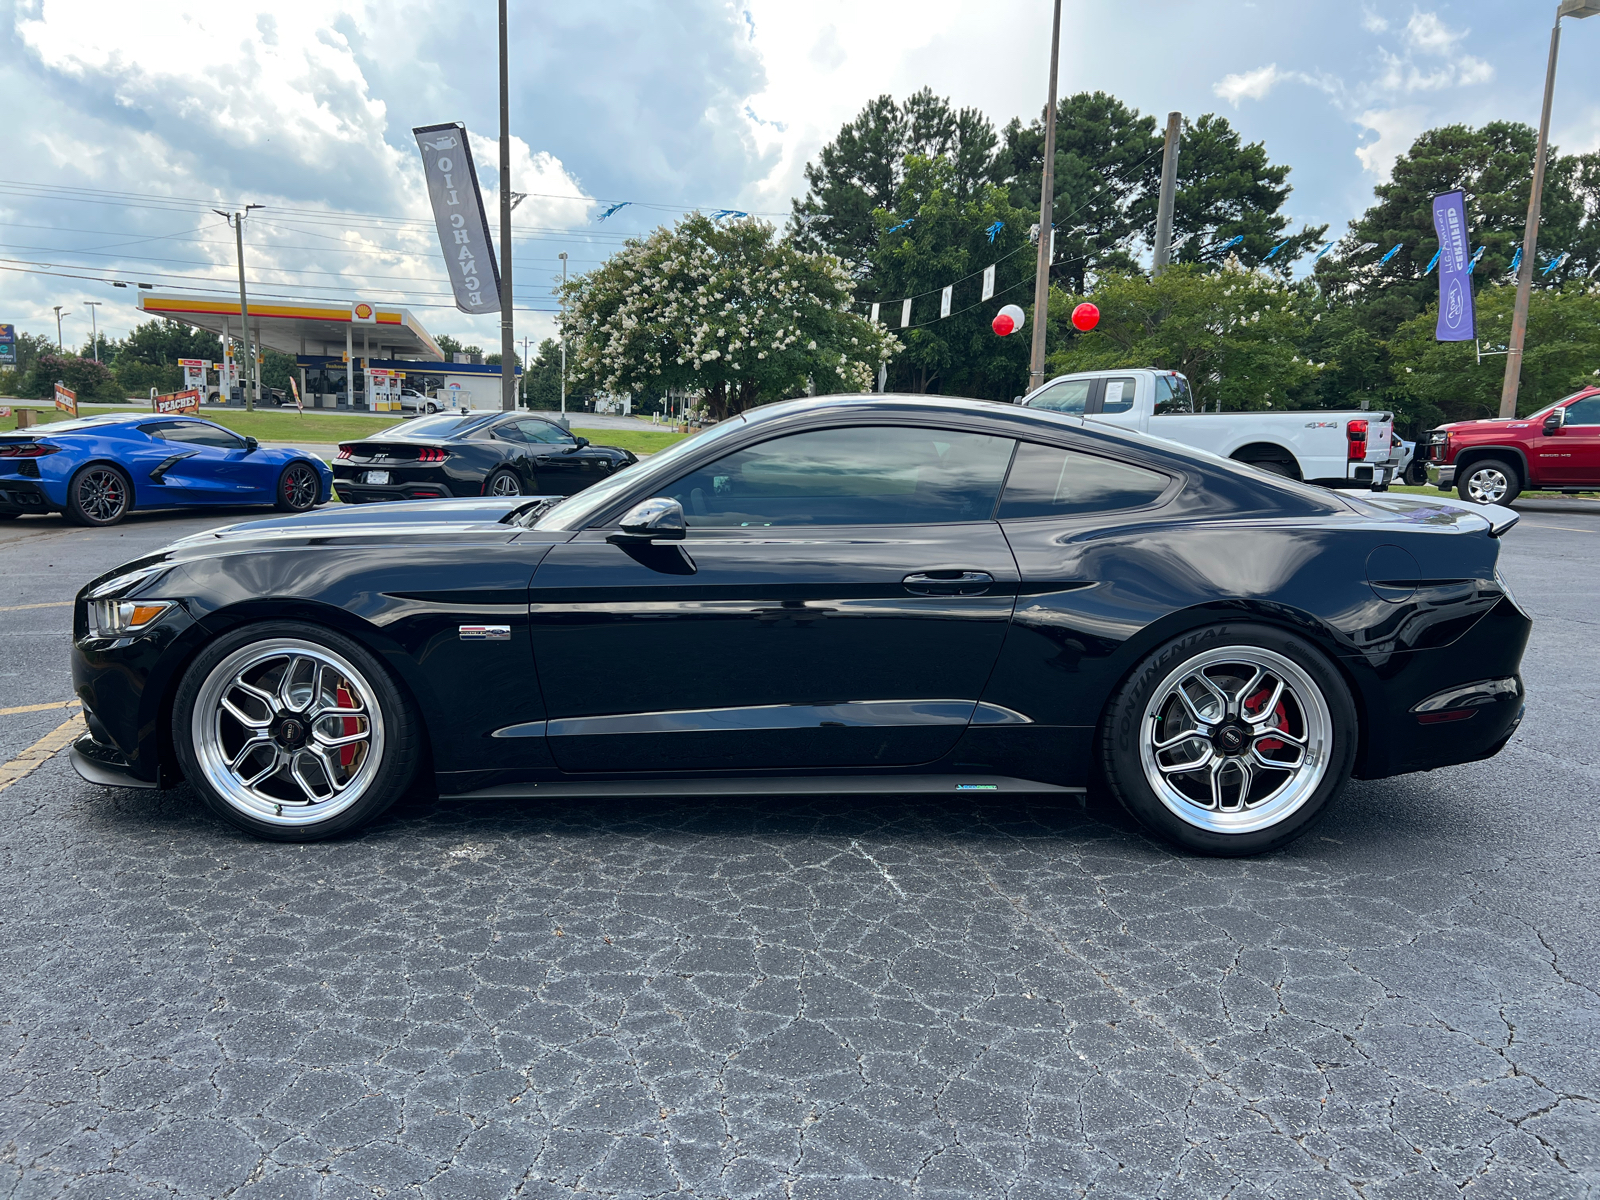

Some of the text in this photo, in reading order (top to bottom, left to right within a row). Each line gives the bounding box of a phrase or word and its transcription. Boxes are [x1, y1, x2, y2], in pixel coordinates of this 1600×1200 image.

[56, 391, 74, 408] PEACHES
[158, 396, 196, 413] PEACHES
[1119, 626, 1231, 751] CONTINENTAL
